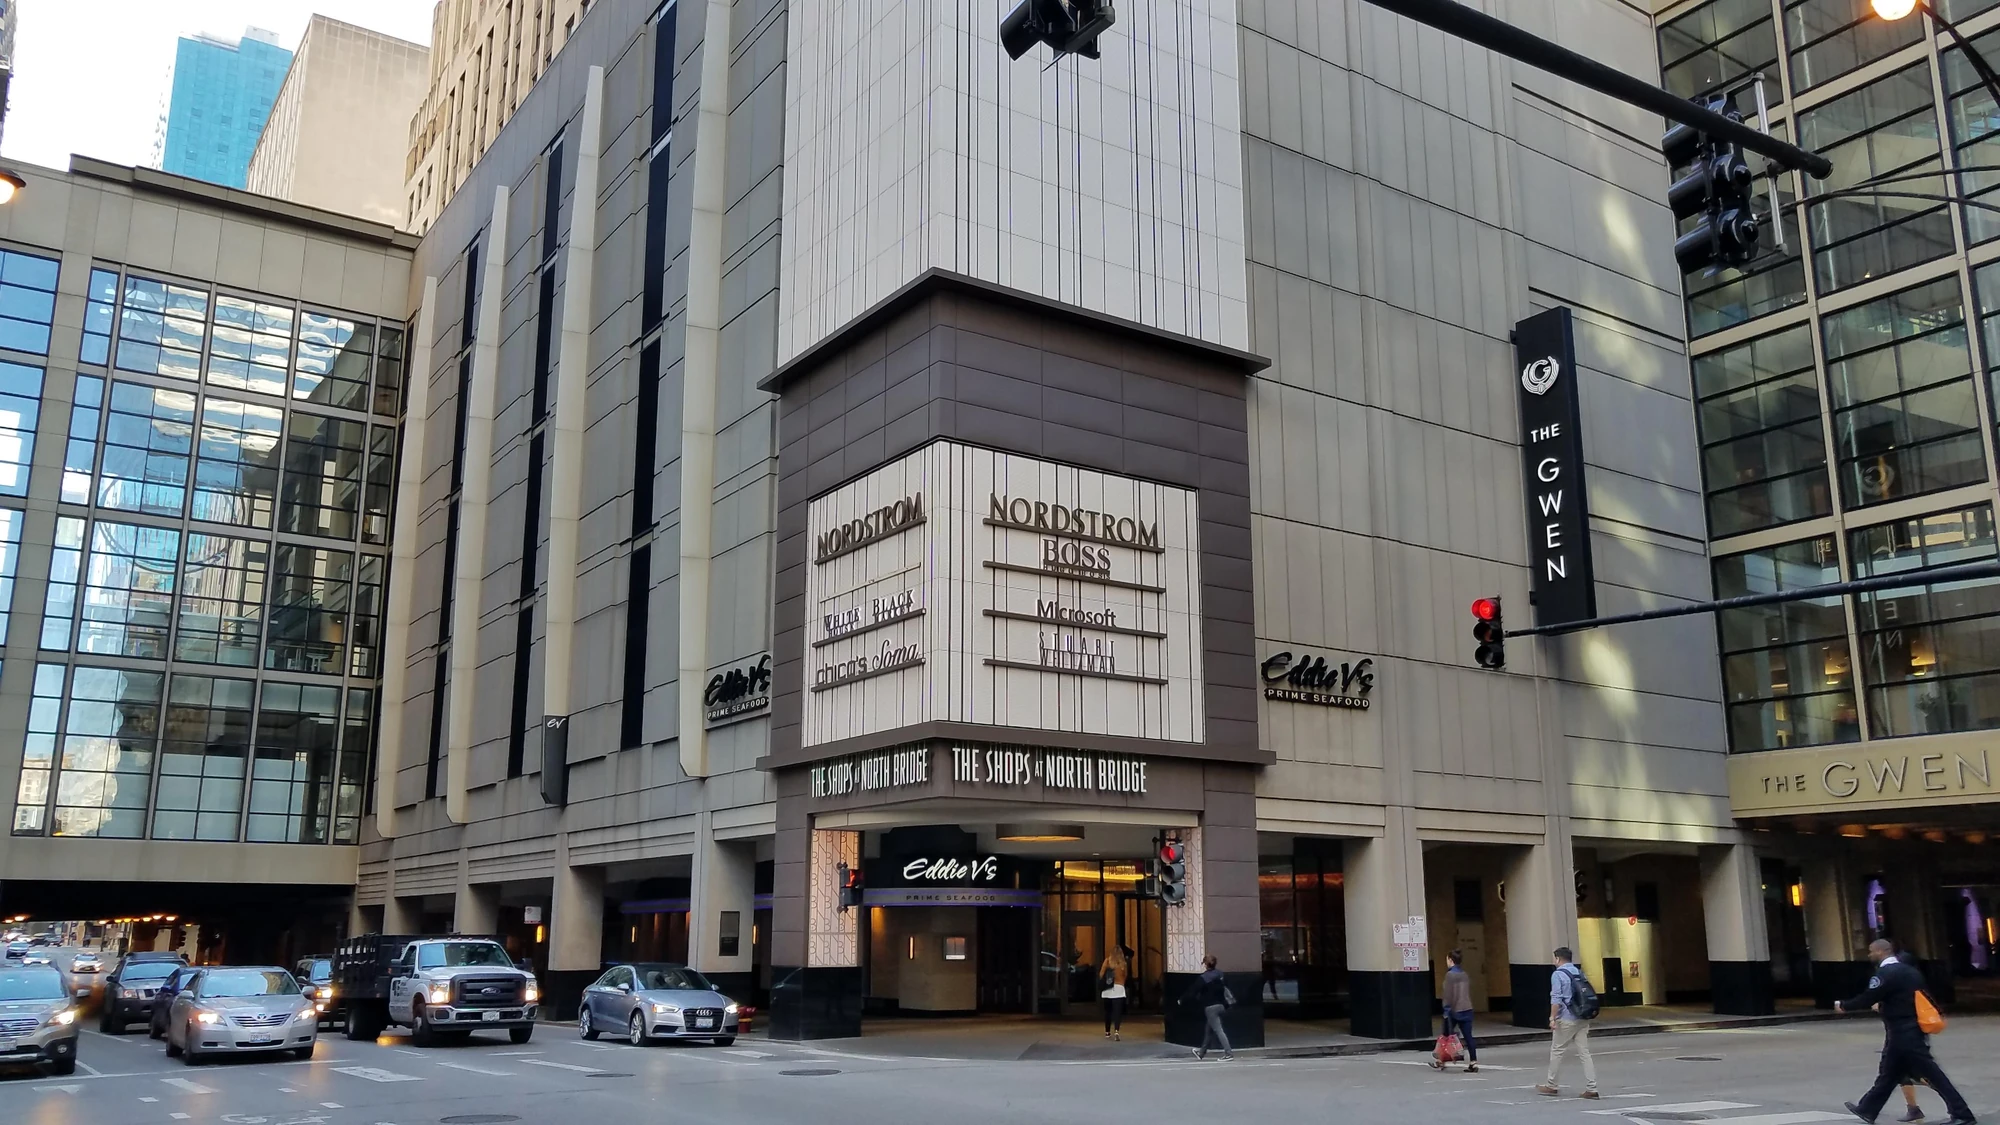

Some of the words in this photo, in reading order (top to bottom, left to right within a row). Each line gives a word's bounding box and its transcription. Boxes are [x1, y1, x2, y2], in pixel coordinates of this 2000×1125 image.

[1530, 423, 1561, 443] THE
[817, 491, 922, 559] NORDSTROM
[990, 492, 1159, 550] NORDSTROM
[1537, 457, 1567, 582] GWEN
[1043, 538, 1111, 571] BOSS
[872, 589, 914, 616] BLACK
[1037, 599, 1117, 628] Microsoft
[872, 639, 919, 670] Soma
[1040, 631, 1115, 658] STUART
[816, 655, 868, 686] chico's
[1261, 651, 1338, 687] Eddie
[1341, 658, 1374, 693] V's
[707, 706, 729, 719] PRIME
[732, 697, 766, 713] SEAFOOD
[1268, 688, 1307, 701] PRIME
[1313, 693, 1369, 708] SEAFOOD
[811, 766, 826, 798] THE
[827, 762, 853, 796] SHOPS
[861, 755, 890, 791] NORTH
[893, 748, 928, 787] BRIDGE
[952, 748, 980, 782] THE
[986, 750, 1031, 785] SHOPS
[1035, 760, 1044, 778] AT
[1046, 754, 1092, 790] NORTH
[1099, 758, 1147, 793] BRIDGE
[1761, 774, 1807, 794] THE
[1821, 749, 1992, 798] GWEN
[903, 857, 968, 880] Eddie
[971, 856, 997, 880] V's
